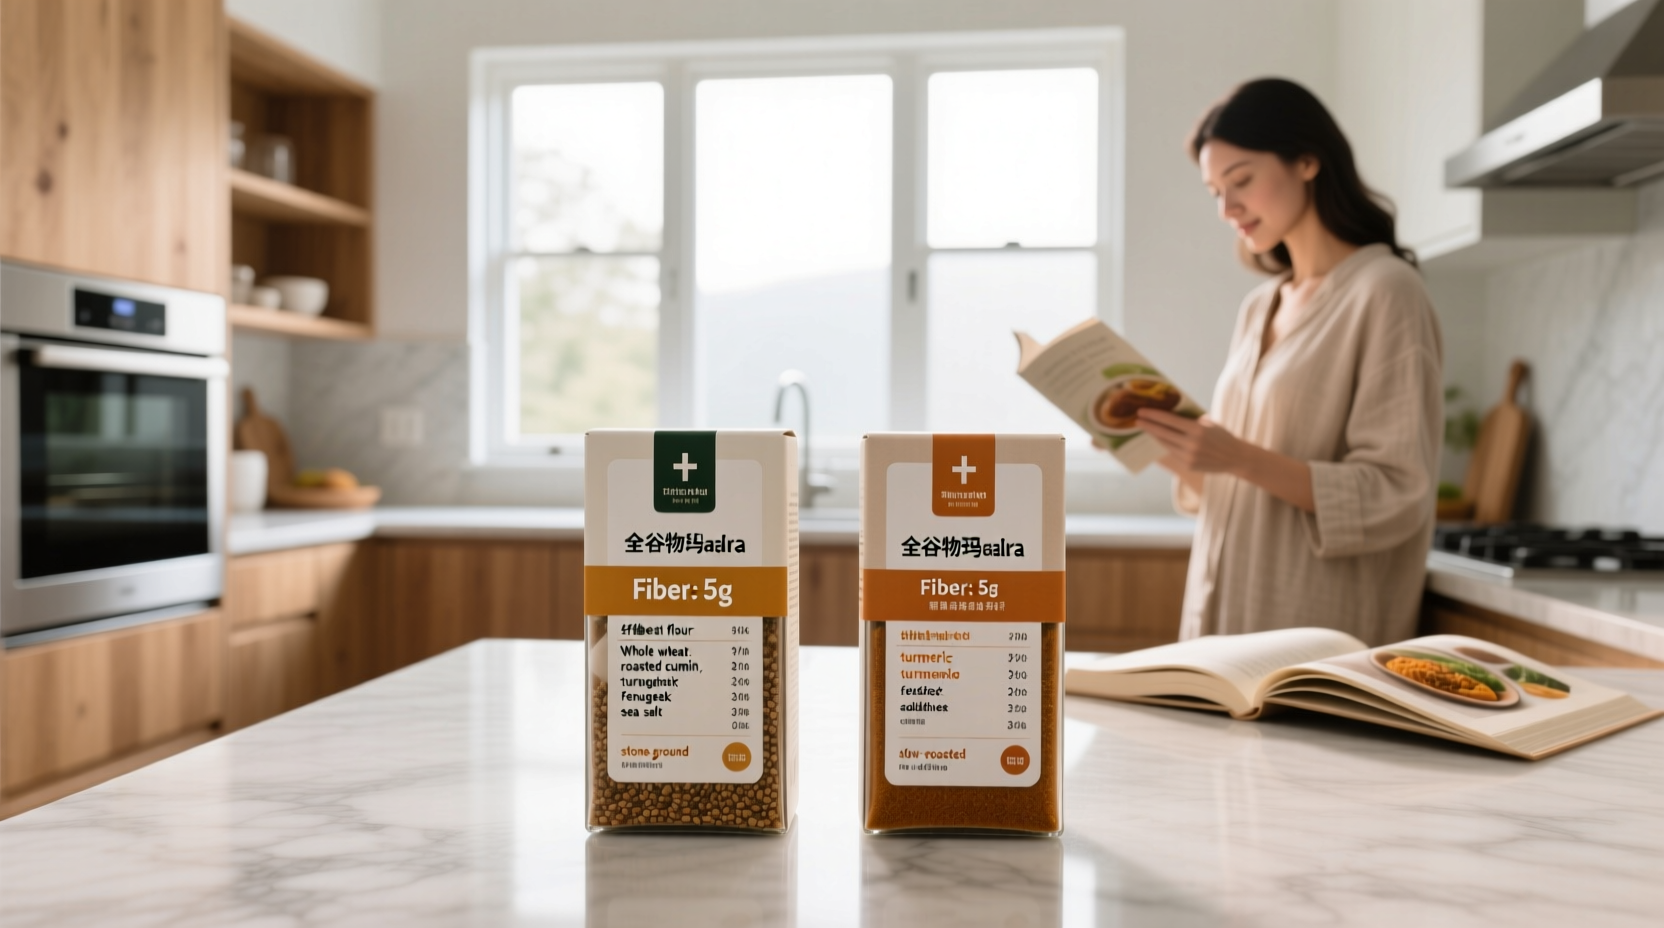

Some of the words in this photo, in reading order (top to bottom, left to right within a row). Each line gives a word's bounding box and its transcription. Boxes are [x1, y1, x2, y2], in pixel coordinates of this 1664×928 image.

[633, 577, 698, 600] Fiber:
[703, 577, 733, 608] 5g
[920, 578, 973, 596] Fiber:
[977, 579, 999, 598] 5g
[620, 645, 654, 657] Whole
[620, 660, 662, 672] roasted
[620, 708, 640, 717] sea
[643, 706, 663, 717] salt
